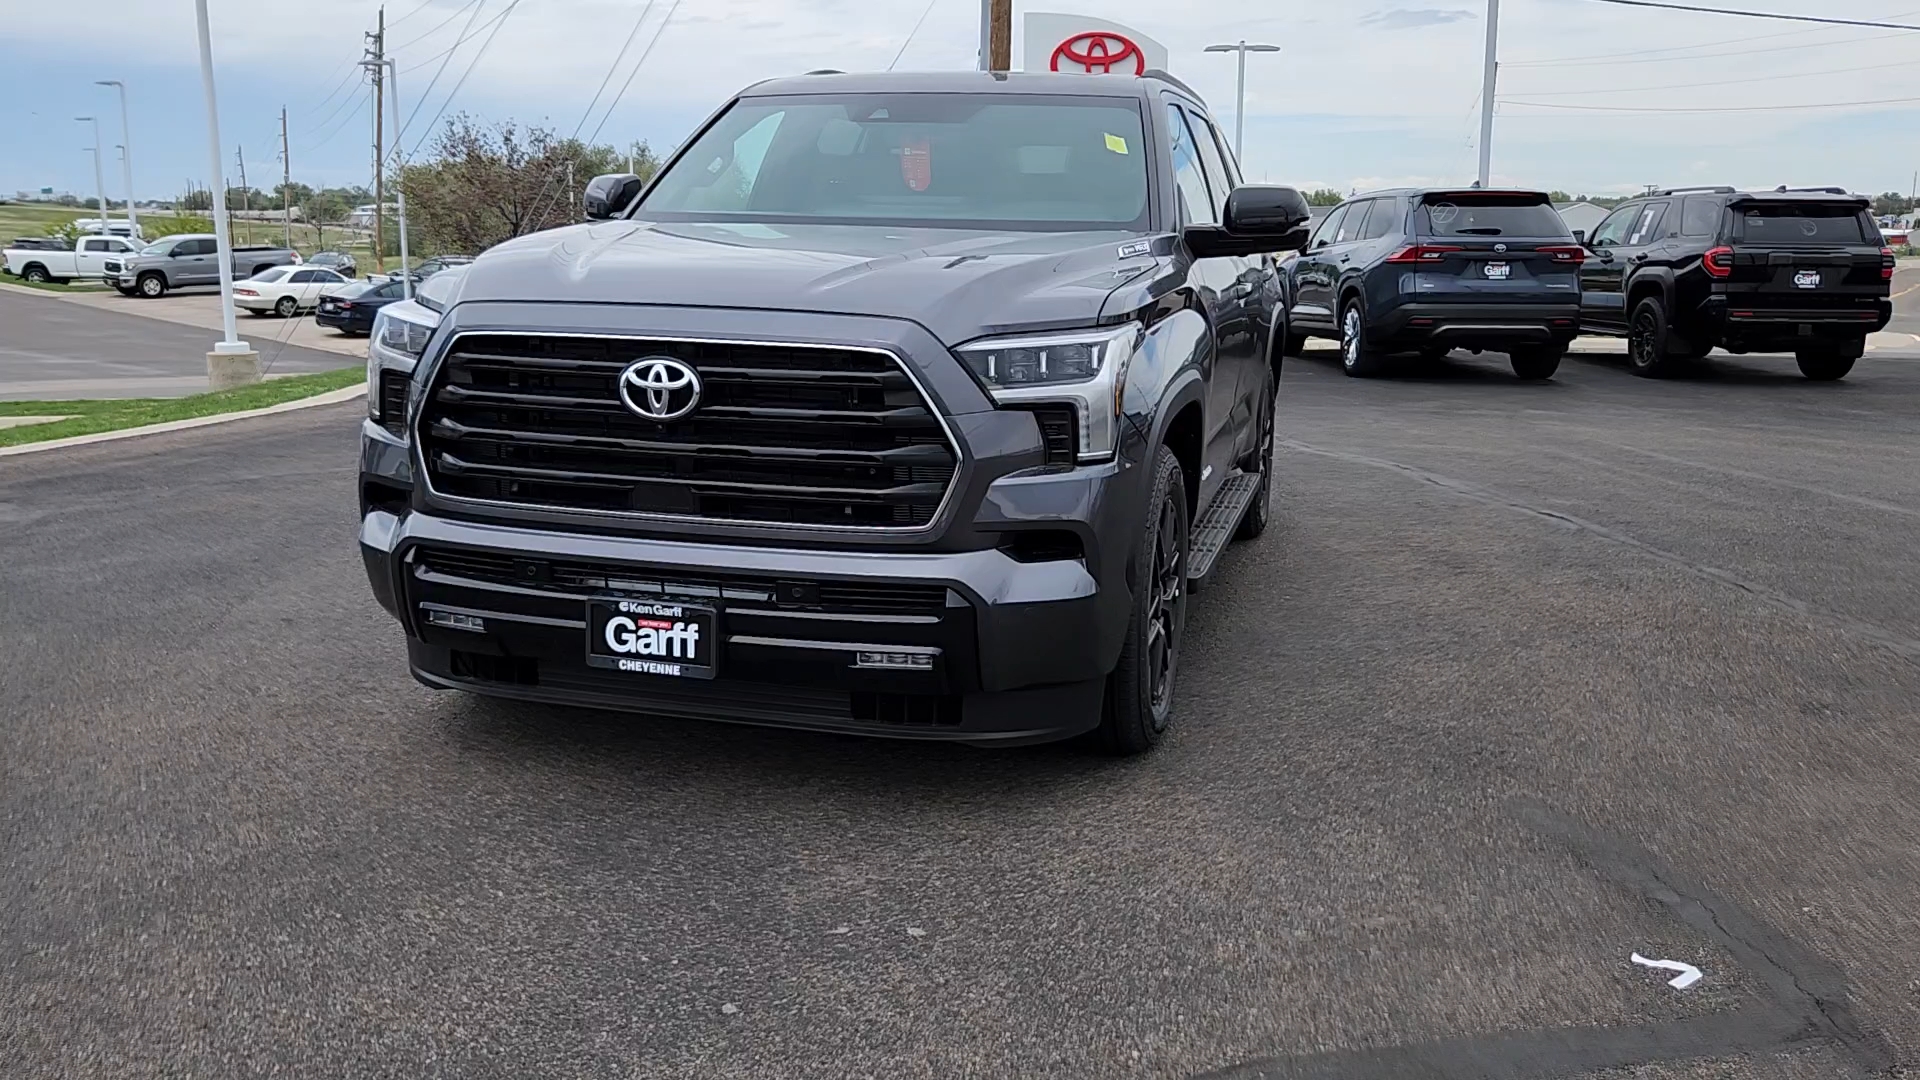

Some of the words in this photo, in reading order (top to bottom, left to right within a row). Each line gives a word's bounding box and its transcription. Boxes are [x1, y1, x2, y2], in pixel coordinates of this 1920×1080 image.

[629, 602, 653, 615] Ken
[653, 604, 683, 617] Garff
[605, 616, 699, 659] Garff
[618, 659, 681, 676] CHEYENNE
